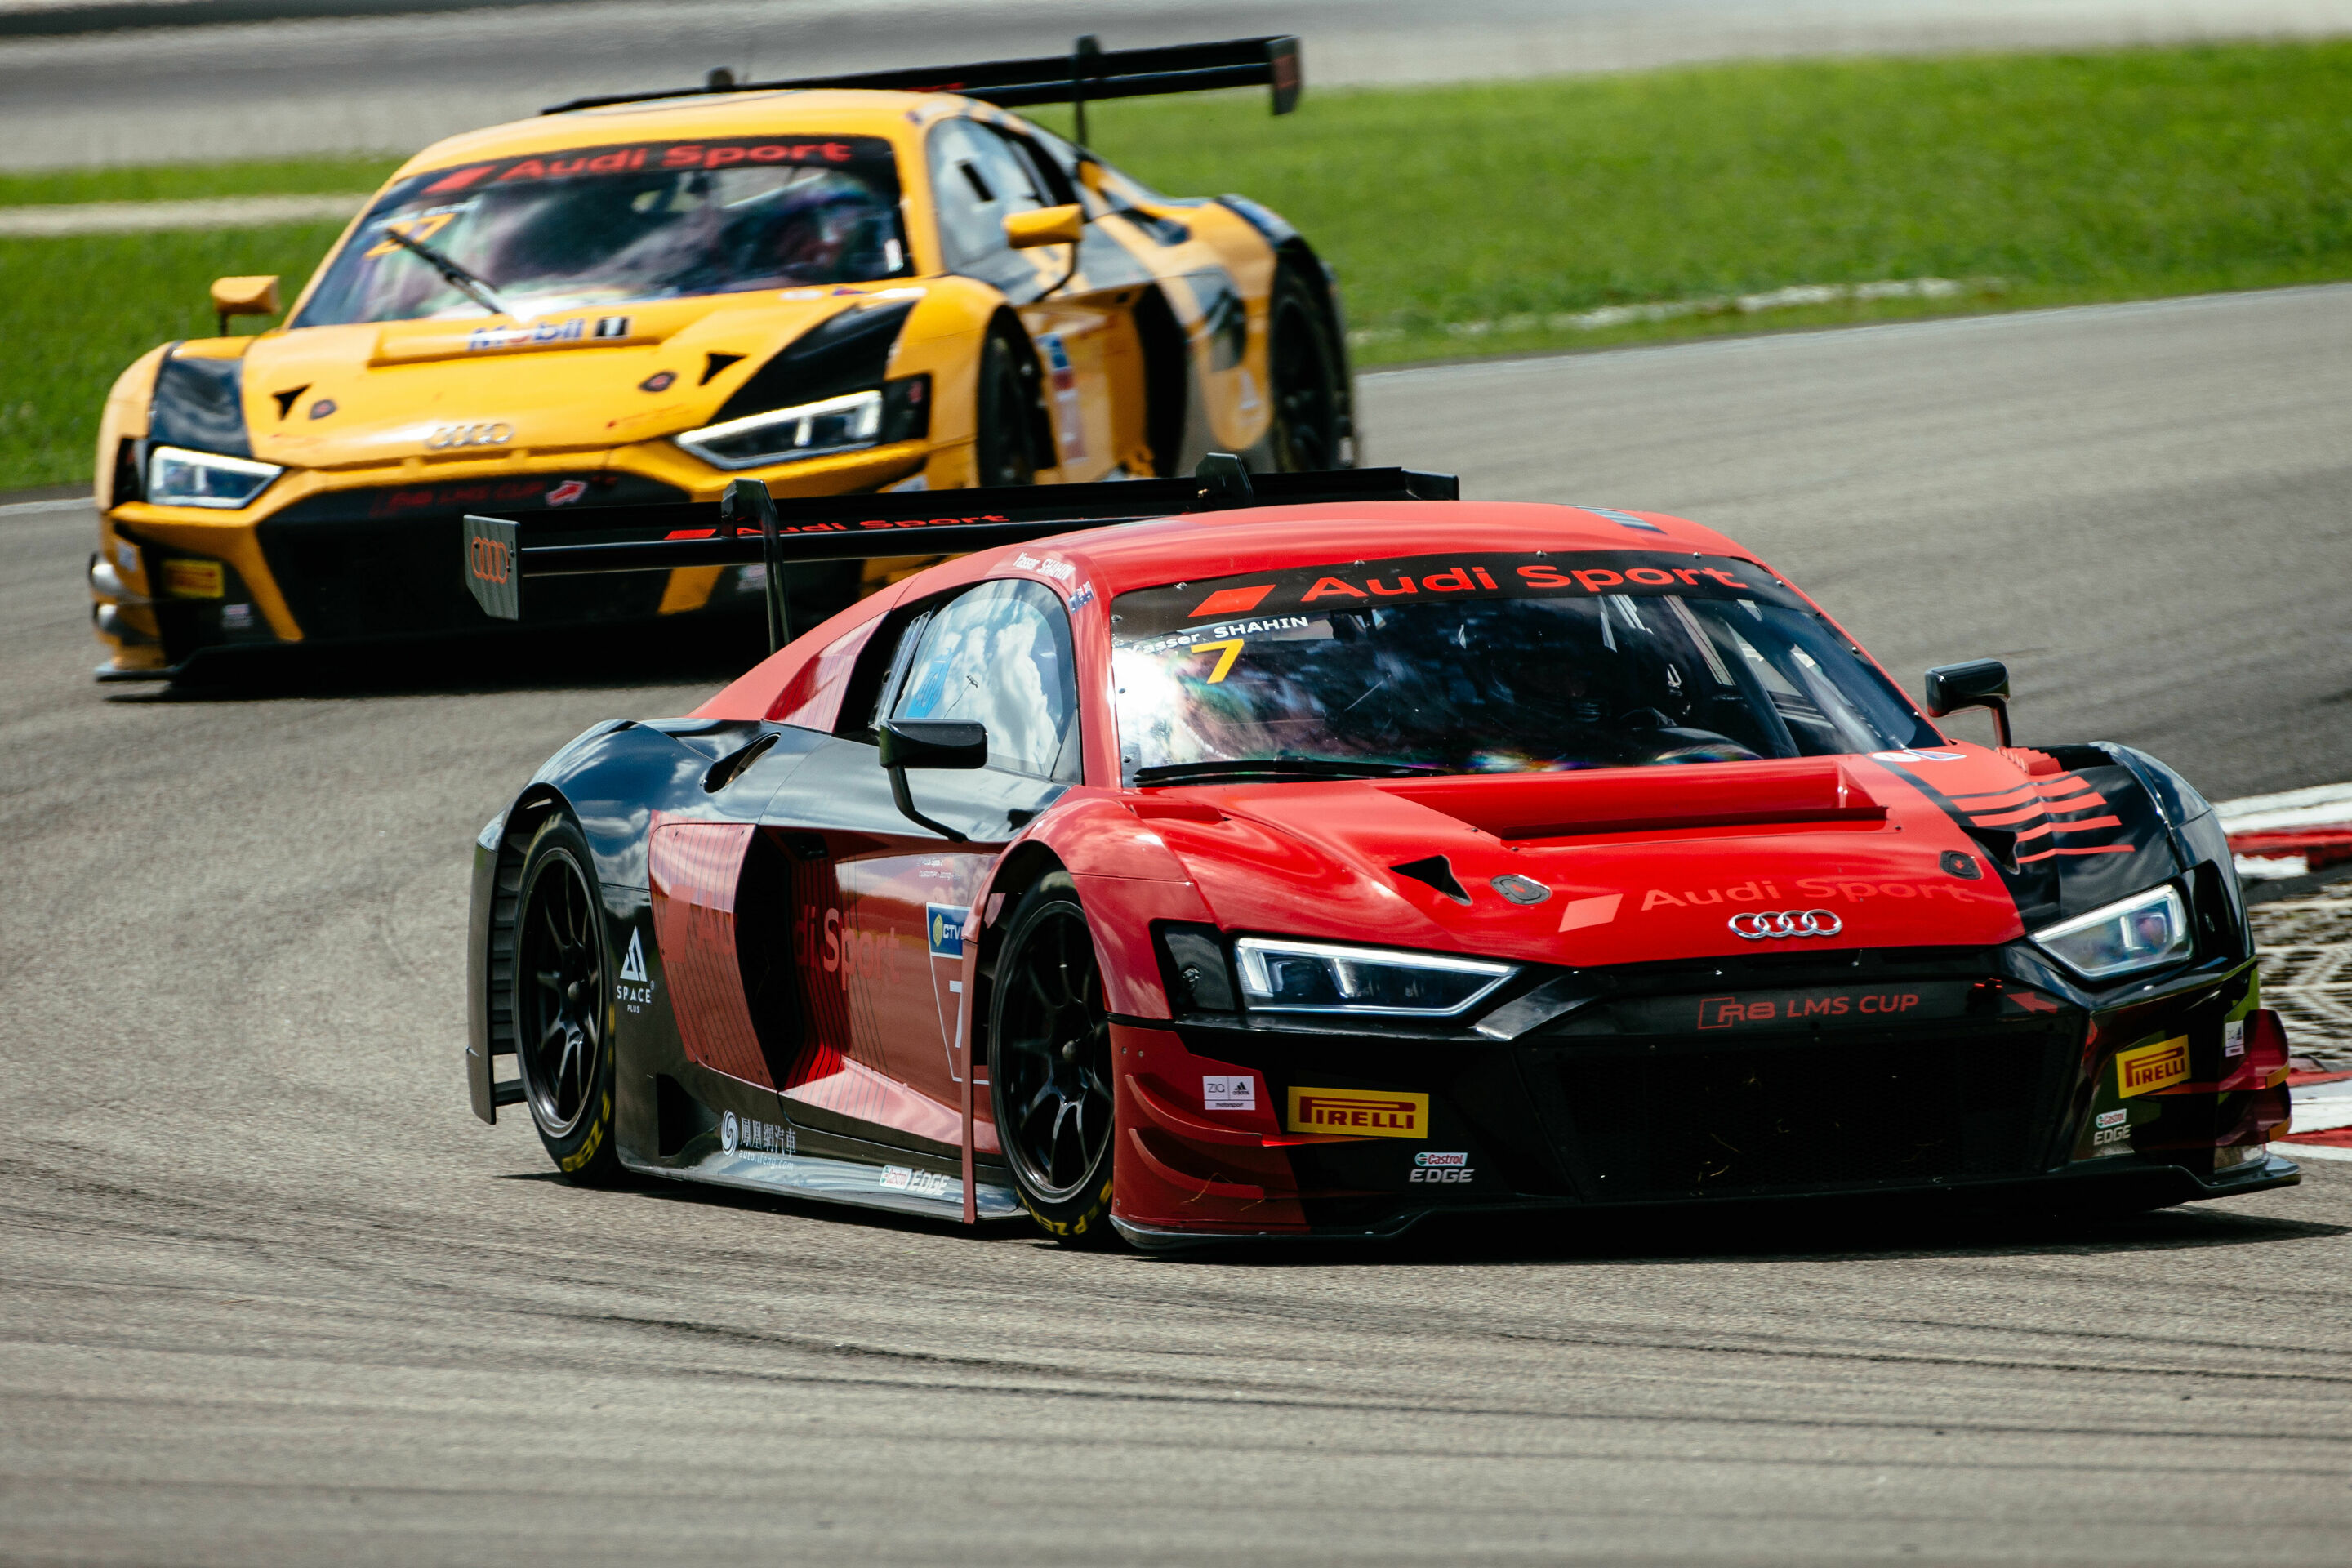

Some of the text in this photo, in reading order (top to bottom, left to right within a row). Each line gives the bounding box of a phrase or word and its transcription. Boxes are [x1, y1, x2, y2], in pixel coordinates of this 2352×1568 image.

[497, 141, 852, 180] Audi Sport
[859, 514, 1010, 529] Sport
[1301, 565, 1748, 602] Audi Sport
[1125, 616, 1309, 655] Yasser SHAHIN
[1191, 638, 1245, 684] 7
[1641, 878, 1975, 911] Audi Sport
[942, 924, 964, 940] CTV
[823, 908, 899, 991] Sport
[617, 985, 651, 1004] SPACE
[627, 1004, 640, 1013] PLUS
[1713, 994, 1919, 1025] R8 LMS CUP
[2126, 1045, 2185, 1089] PIRELLI
[1299, 1096, 1416, 1130] PIRELLI
[740, 1116, 796, 1158] 鳳凰網汽車
[2093, 1124, 2132, 1145] EDGE
[738, 1149, 794, 1171] auto.ifeng.com
[1428, 1154, 1463, 1165] Castrol
[1409, 1169, 1475, 1183] EDGE
